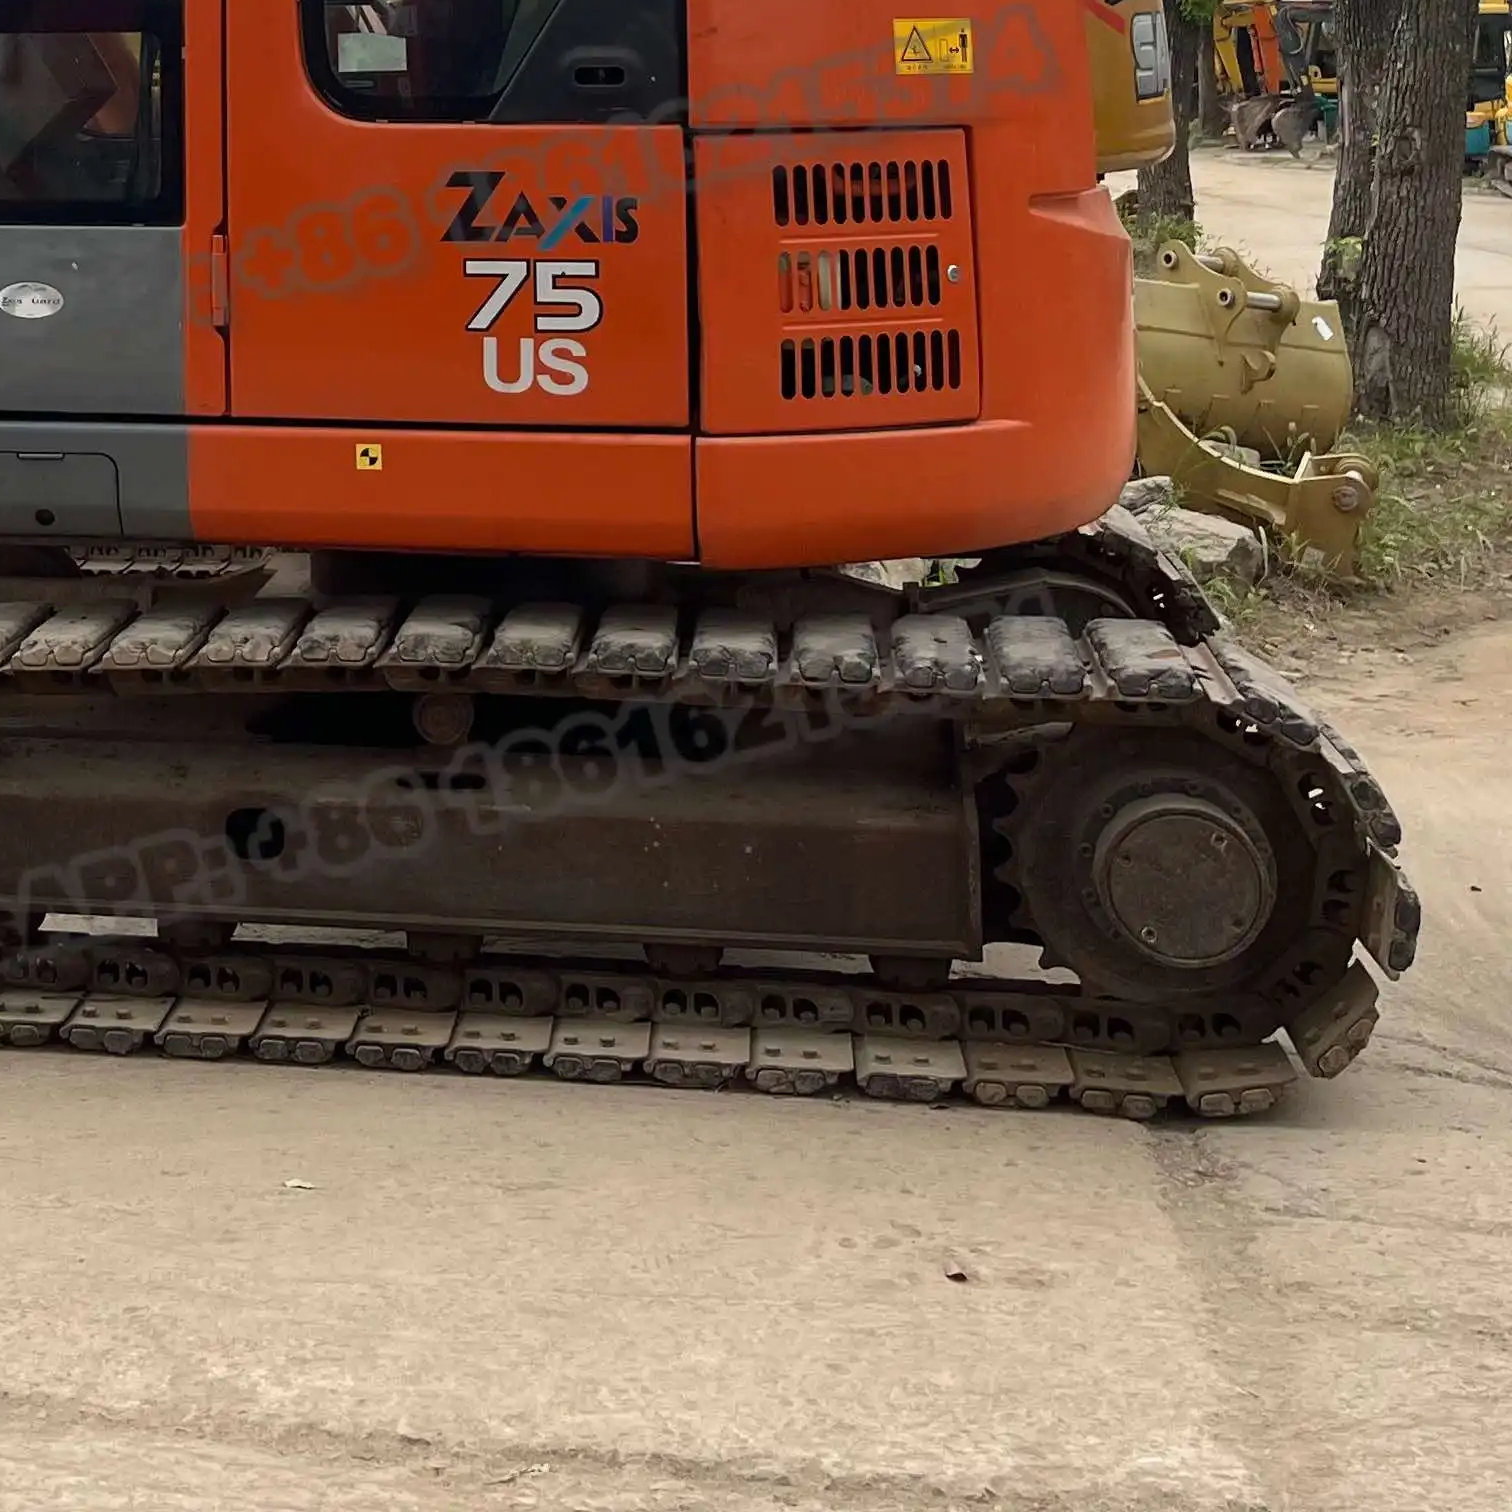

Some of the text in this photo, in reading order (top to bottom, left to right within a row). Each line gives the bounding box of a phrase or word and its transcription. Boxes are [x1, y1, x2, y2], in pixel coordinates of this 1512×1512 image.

[440, 171, 639, 250] ZAXIS
[463, 257, 604, 334] 75
[483, 336, 589, 396] US
